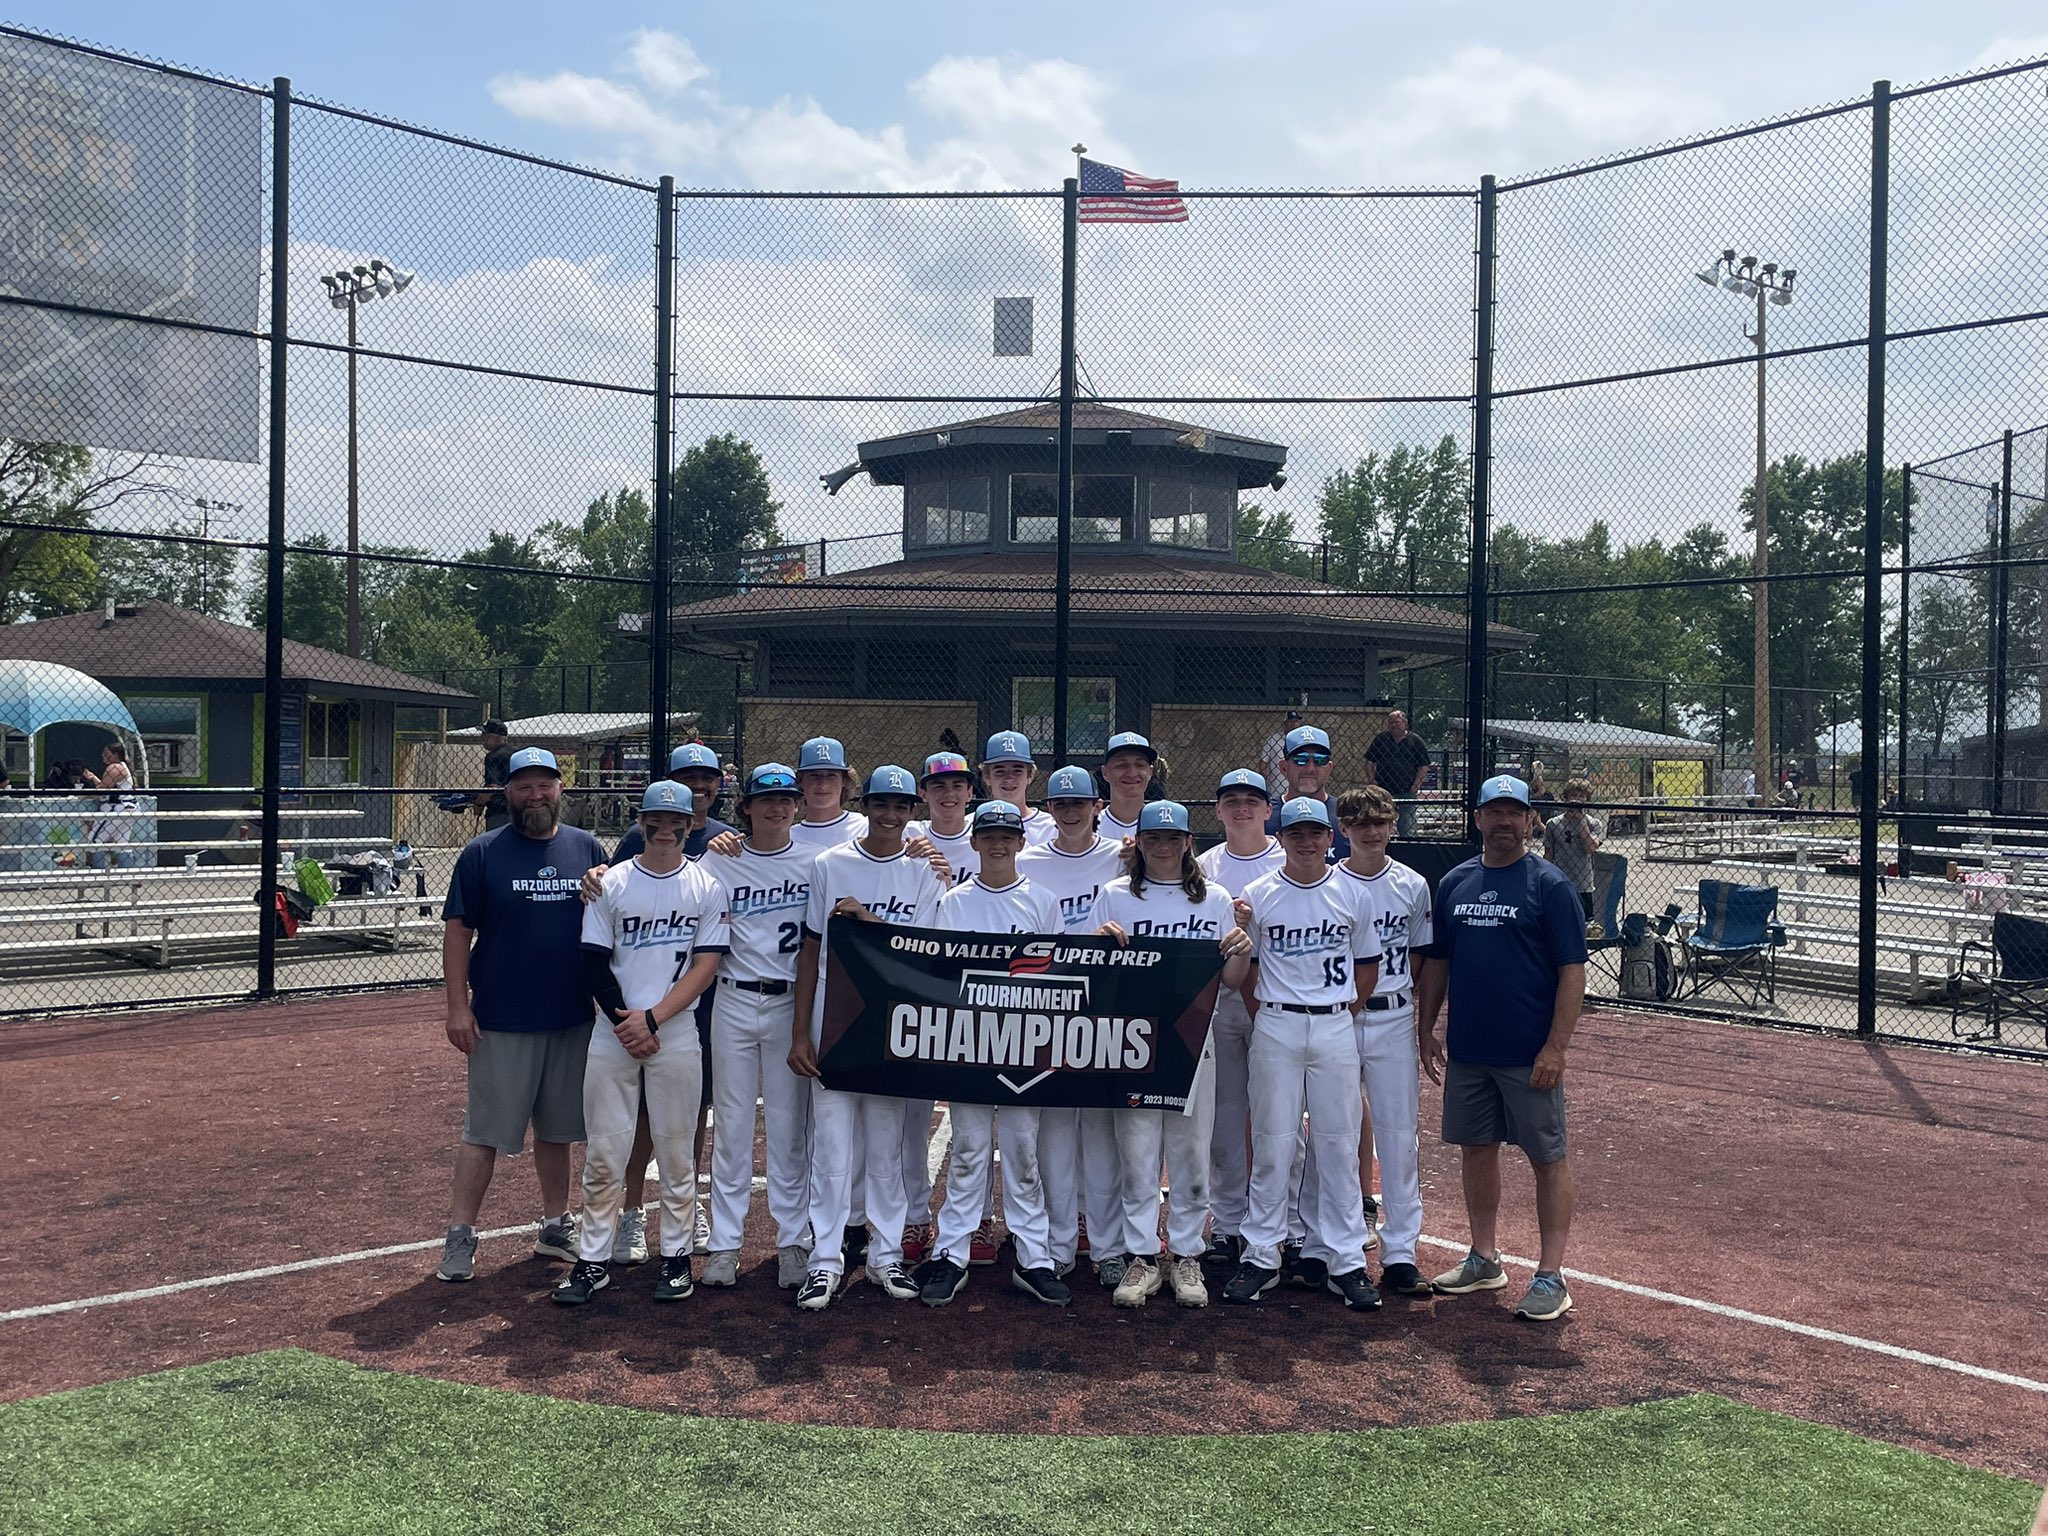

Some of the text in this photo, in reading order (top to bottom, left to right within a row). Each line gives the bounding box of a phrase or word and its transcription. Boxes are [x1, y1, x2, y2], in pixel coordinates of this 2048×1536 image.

[512, 879, 583, 891] RAZORBACK
[532, 891, 566, 901] Baseball
[1453, 903, 1519, 919] RAZORBACK
[890, 935, 941, 956] OHIO
[944, 941, 1017, 959] VALLEY
[1107, 950, 1162, 967] PREP
[671, 950, 688, 983] 7
[1323, 956, 1348, 988] 15
[966, 983, 1083, 1012] TOURNAMENT
[889, 1003, 1154, 1070] CHAMPIONS
[1143, 1094, 1163, 1105] 2023
